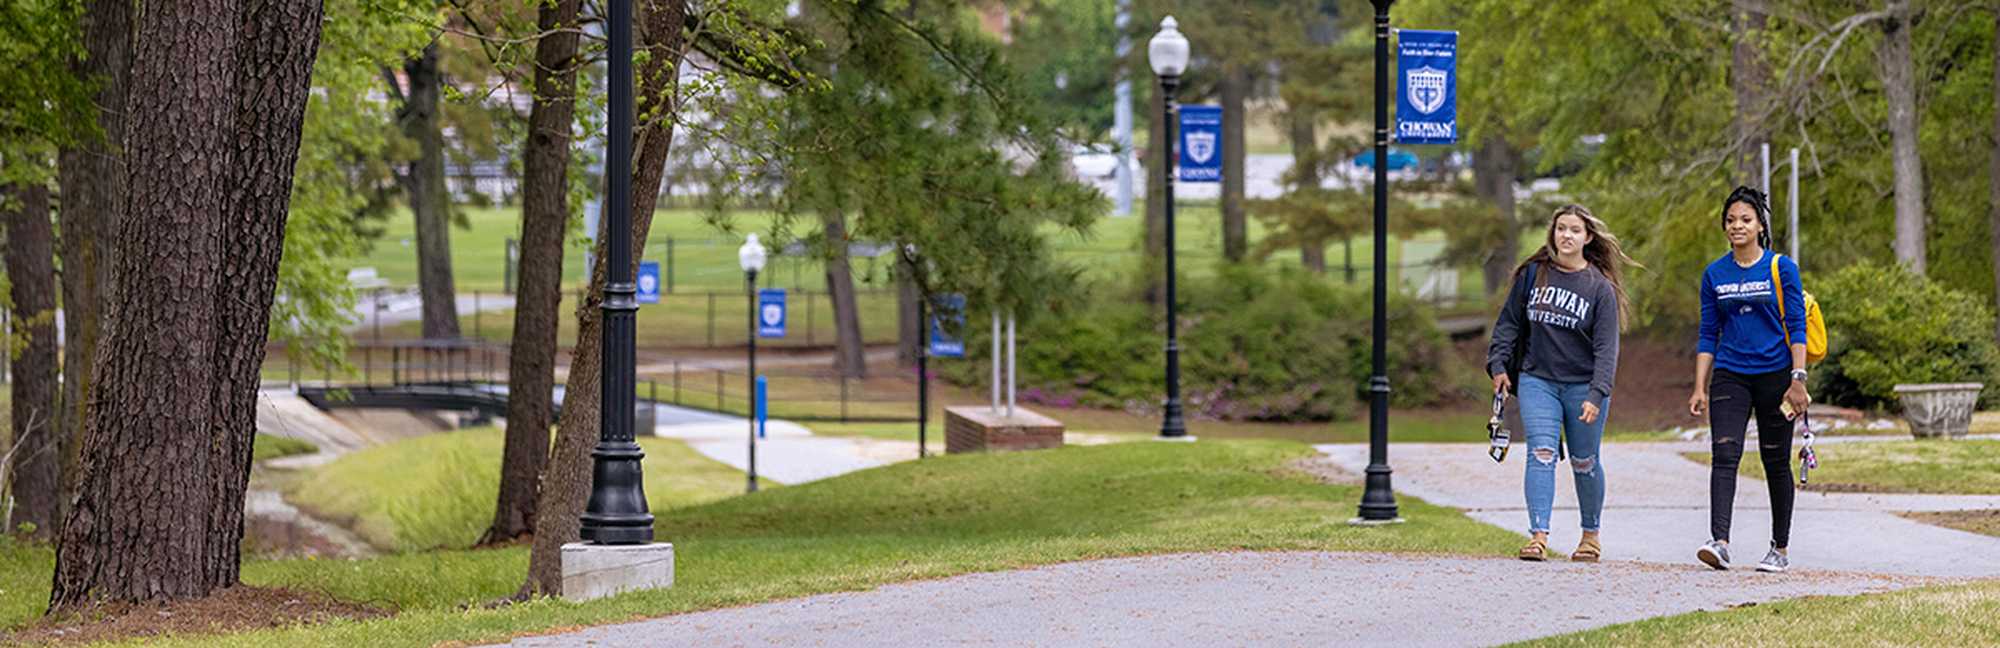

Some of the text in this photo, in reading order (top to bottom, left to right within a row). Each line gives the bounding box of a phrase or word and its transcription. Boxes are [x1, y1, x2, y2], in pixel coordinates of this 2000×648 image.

[1399, 121, 1453, 132] CHOWAN
[1527, 286, 1590, 320] HOWAN
[1528, 309, 1579, 329] NIVERSITY
